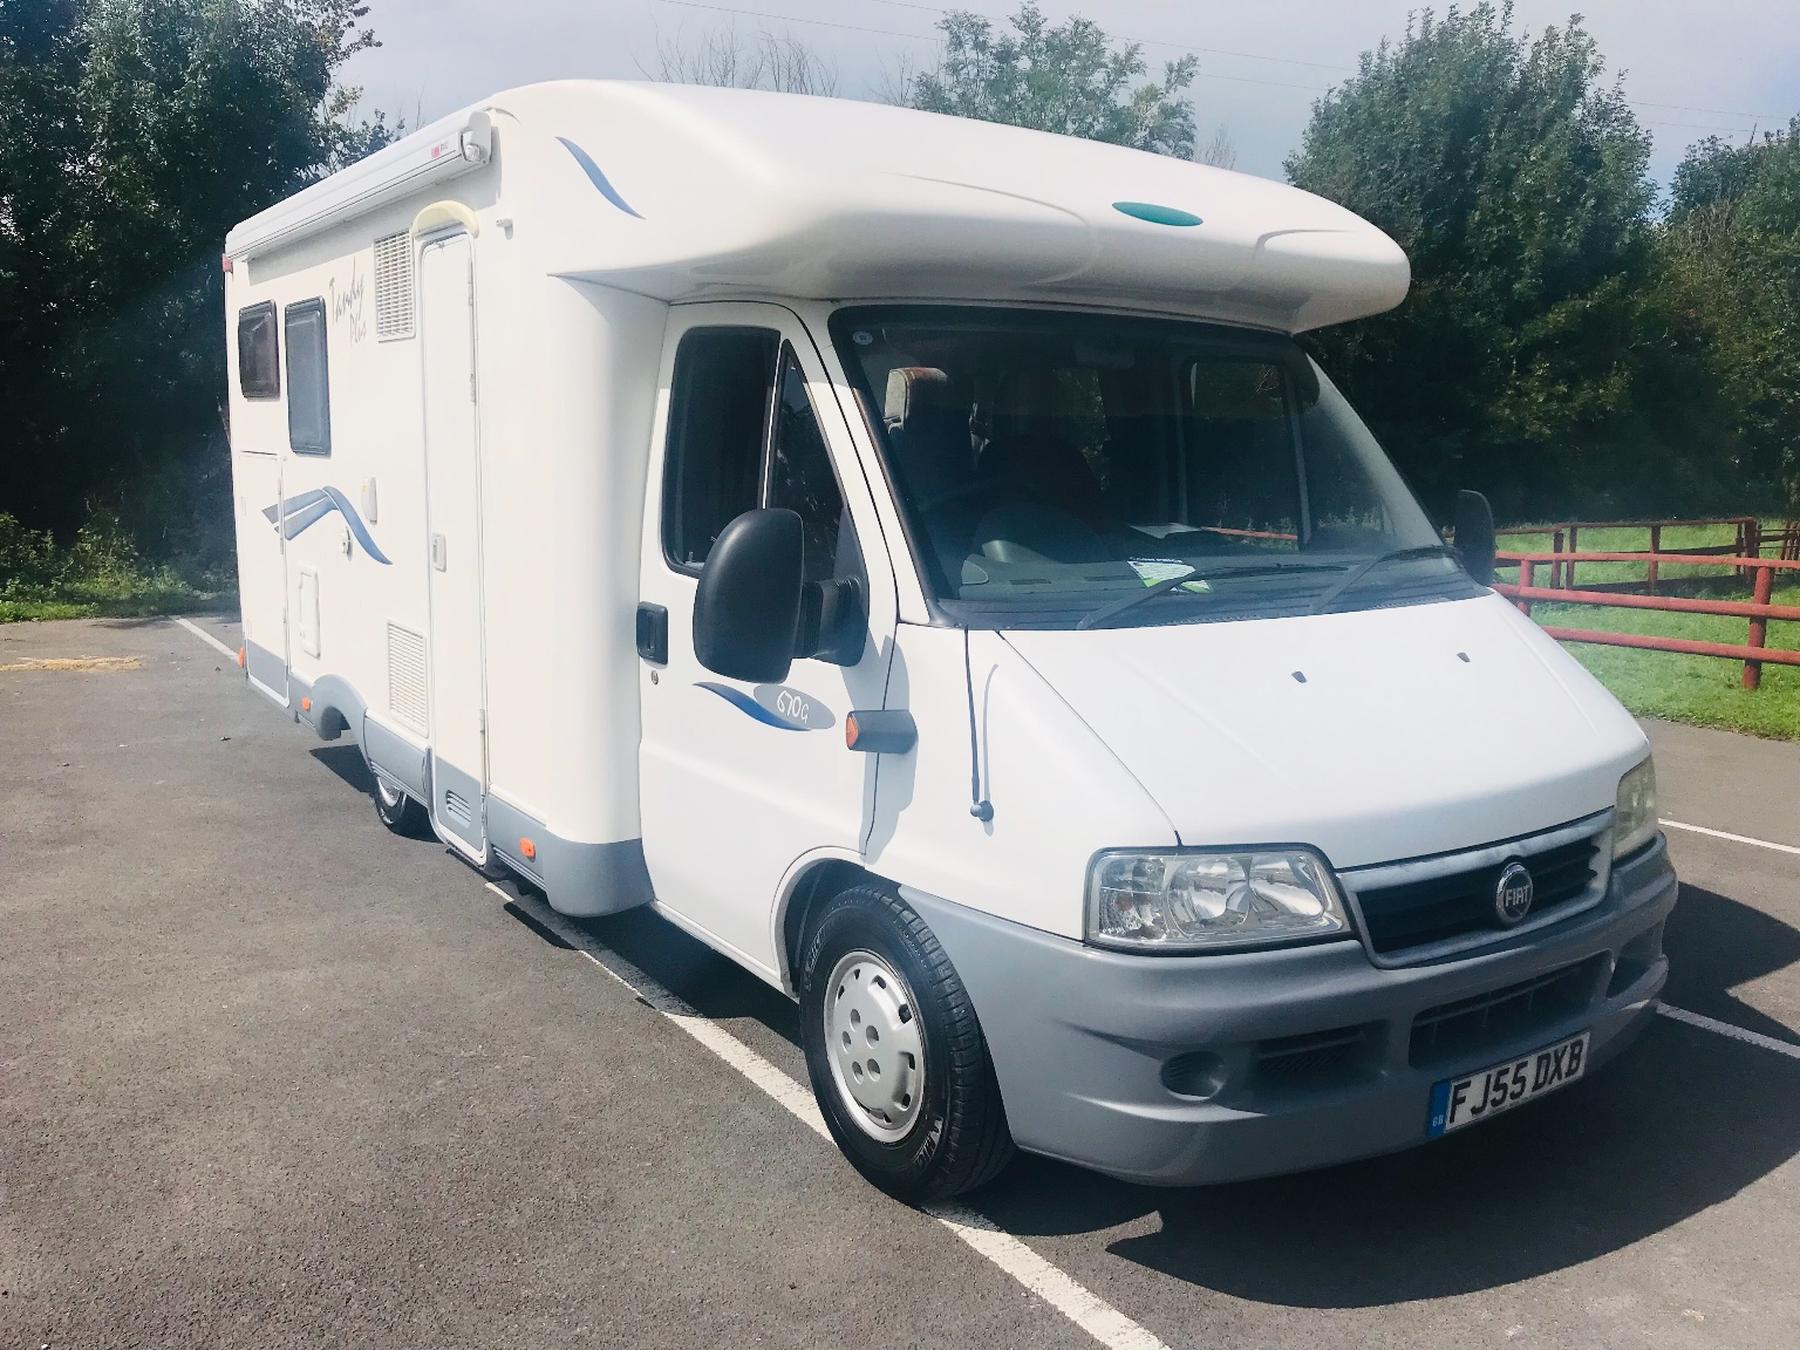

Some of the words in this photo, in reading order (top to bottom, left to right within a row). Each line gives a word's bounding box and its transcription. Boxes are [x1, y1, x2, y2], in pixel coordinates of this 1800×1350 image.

[1505, 885, 1530, 907] FIAT
[1450, 1060, 1528, 1124] FJ55
[1531, 1039, 1584, 1092] DXB
[1432, 1115, 1444, 1127] GB
